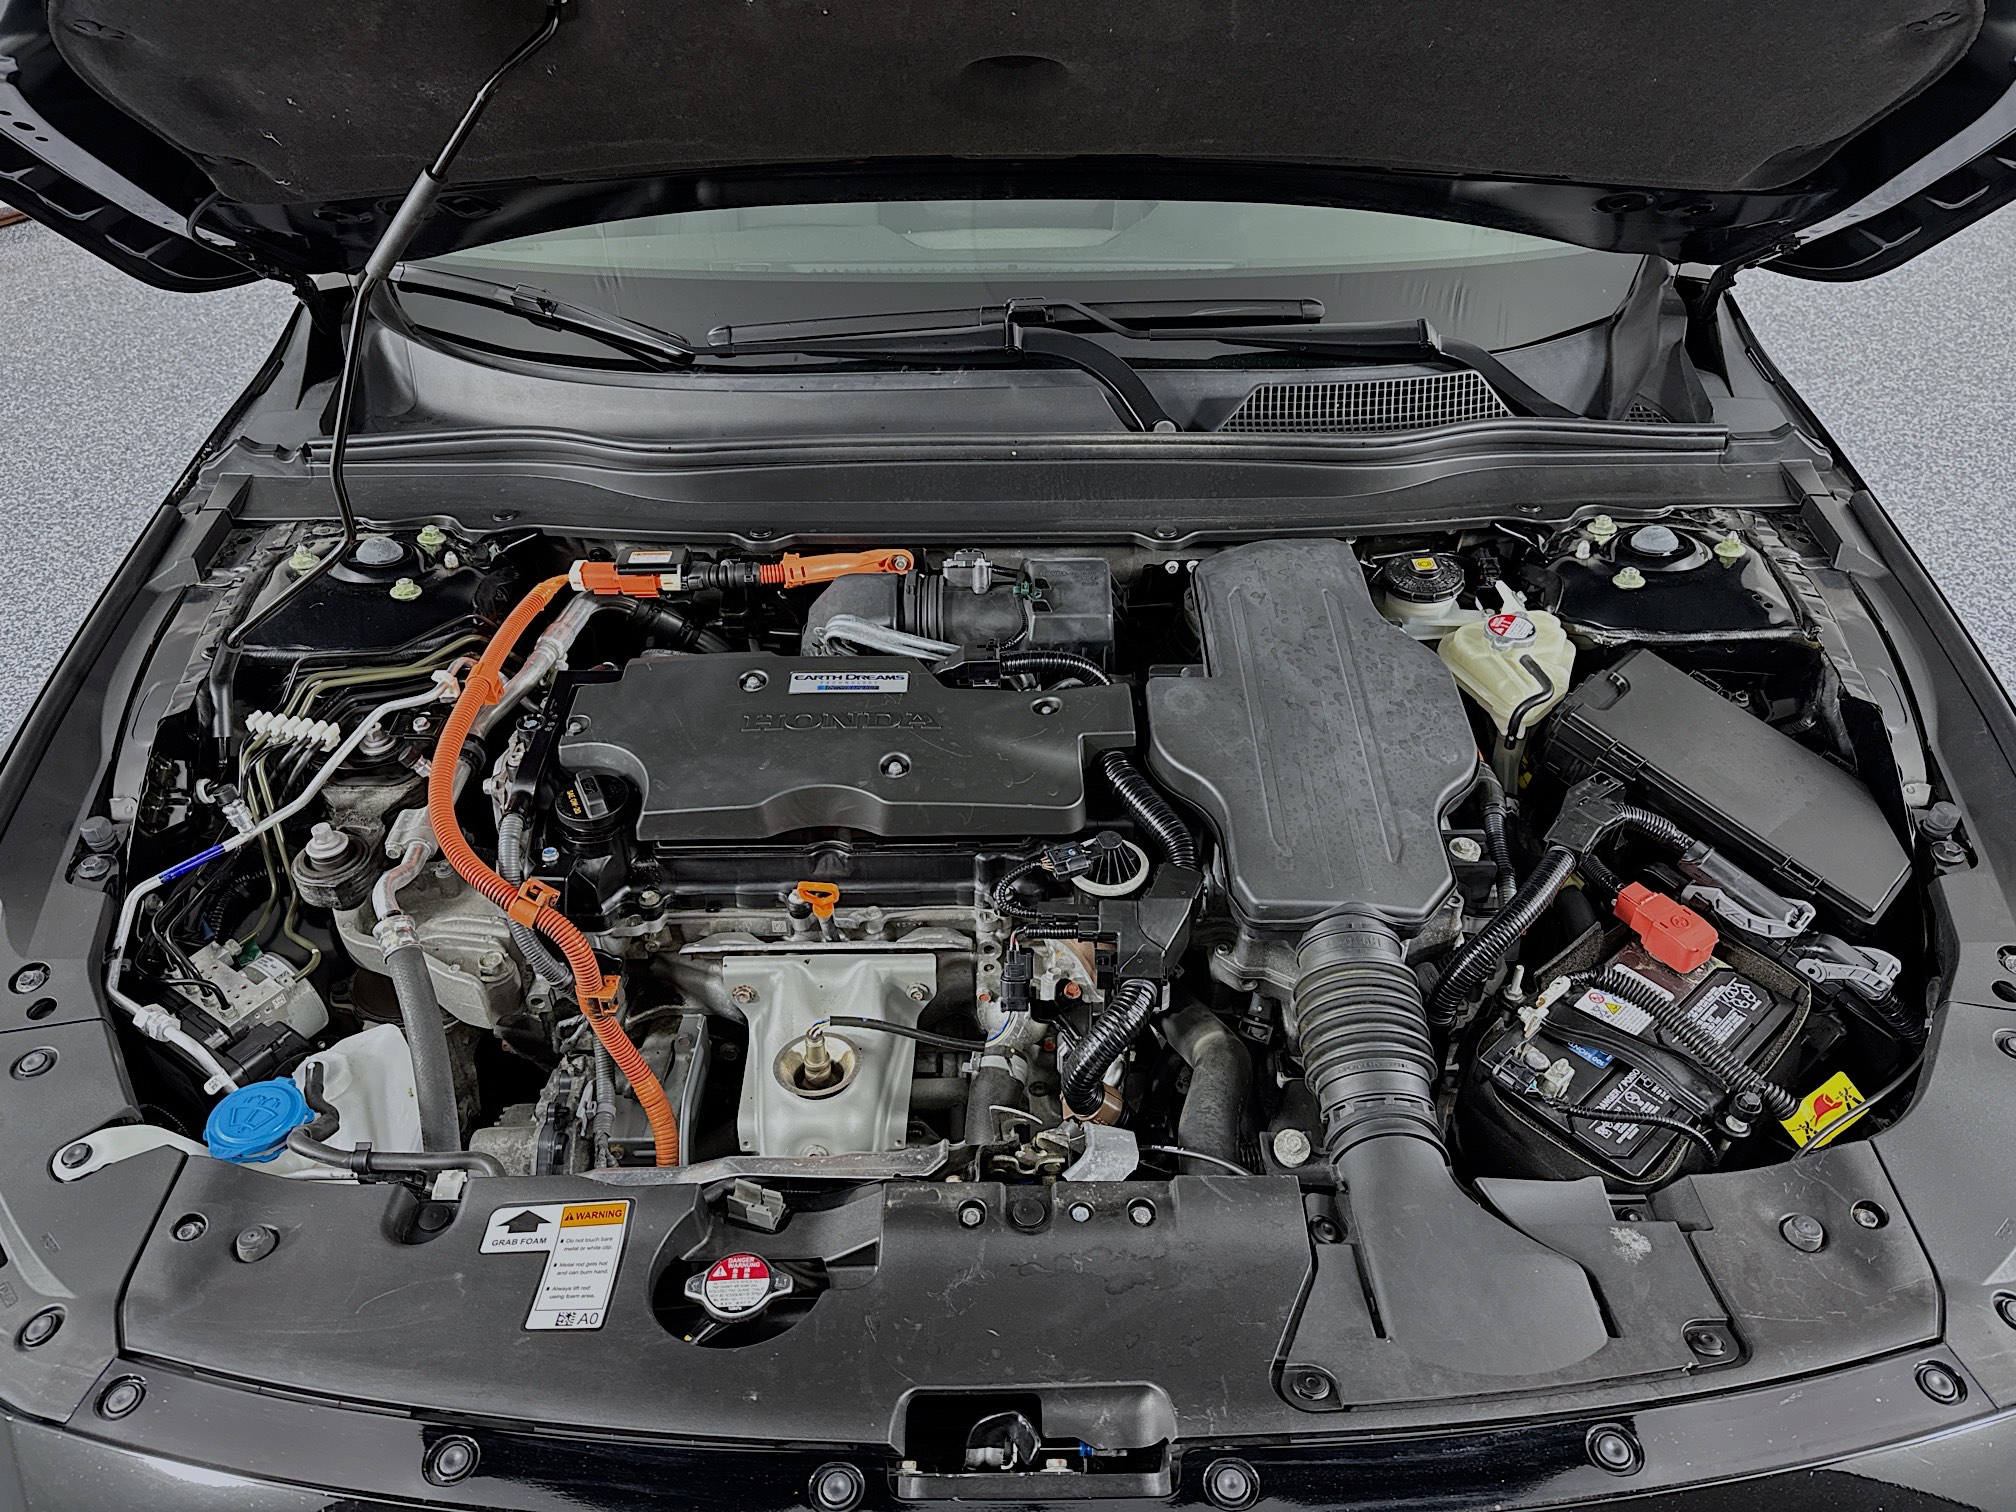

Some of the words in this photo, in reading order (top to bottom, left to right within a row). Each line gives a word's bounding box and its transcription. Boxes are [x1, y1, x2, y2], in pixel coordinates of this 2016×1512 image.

[845, 673, 905, 681] DREAMS
[741, 712, 942, 732] HONDA
[1567, 1041, 1593, 1060] MONT
[1591, 1055, 1605, 1067] 100
[575, 1209, 623, 1220] WARNING
[491, 1238, 518, 1247] GRAB
[519, 1237, 547, 1246] FOAM
[576, 1312, 600, 1325] A0
